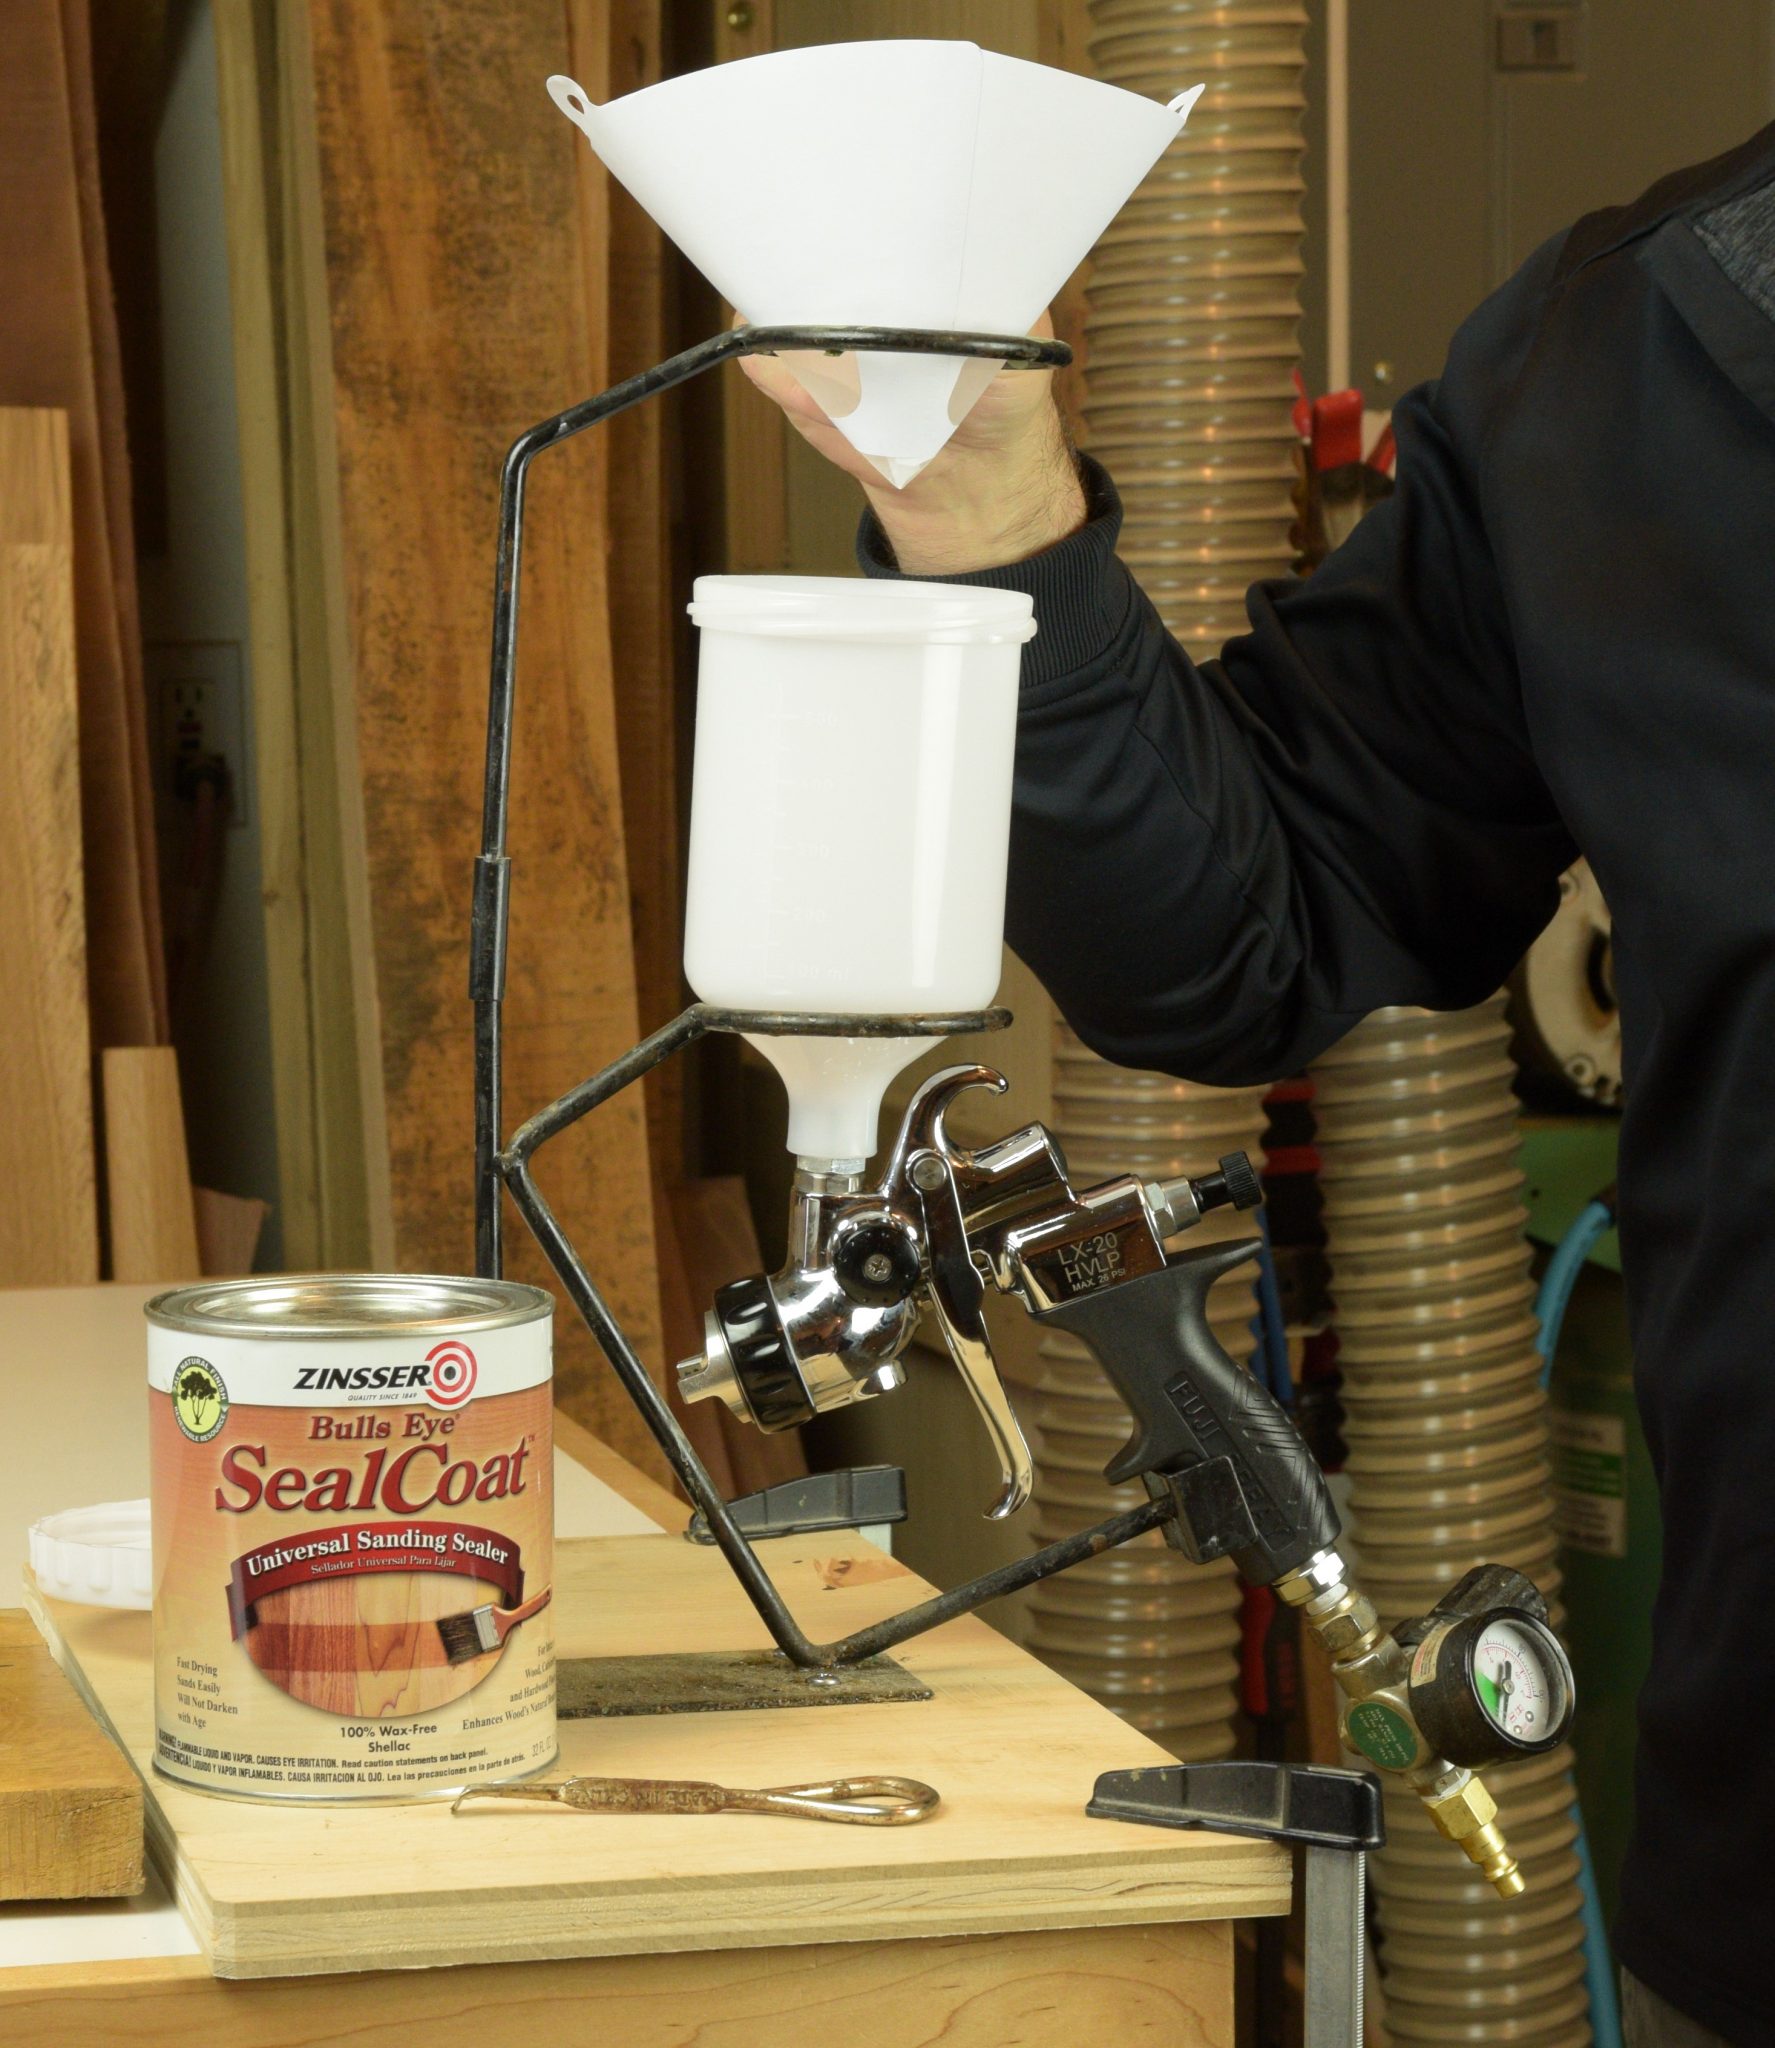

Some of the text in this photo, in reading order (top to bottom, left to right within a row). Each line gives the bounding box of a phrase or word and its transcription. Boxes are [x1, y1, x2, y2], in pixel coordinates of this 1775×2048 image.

[1058, 1232, 1118, 1265] LX-20
[1065, 1251, 1120, 1283] HVLP
[1072, 1278, 1096, 1292] MAX
[180, 1357, 209, 1370] NATURAL
[210, 1369, 227, 1400] FINISH
[1170, 1380, 1220, 1439] FUJI
[308, 1413, 391, 1440] Bulls
[215, 1436, 529, 1514] SealCoat
[246, 1529, 508, 1576] Universal Sanding Sealer
[310, 1555, 456, 1574] Sellador Universal Para Lijar
[176, 1656, 219, 1677] Fast Drying
[176, 1675, 221, 1696] Sands Easily
[510, 1690, 522, 1702] and
[177, 1692, 238, 1714] Will Not Darken
[177, 1711, 207, 1729] with Age
[462, 1715, 503, 1730] Enhances
[505, 1705, 529, 1721] Wood's
[341, 1723, 437, 1739] 100% Wax-Free
[177, 1740, 202, 1756] FLAMMABLE
[203, 1747, 219, 1759] LIQUID
[220, 1750, 231, 1761] AND
[233, 1752, 255, 1764] VAPOR.
[256, 1755, 281, 1767] CAUSES
[283, 1757, 295, 1767] EYE
[297, 1758, 338, 1768] IRRITATION.
[342, 1760, 361, 1768] Read
[364, 1758, 393, 1768] caution
[395, 1755, 437, 1766] statements
[450, 1751, 466, 1761] back
[468, 1747, 488, 1759] panel.
[368, 1740, 411, 1753] Shellac
[193, 1760, 212, 1772] LIQUIDO
[213, 1763, 216, 1772] Y
[218, 1765, 237, 1777] VAPOR
[238, 1768, 285, 1781] INFLAMABLES.
[287, 1772, 311, 1782] CAUSA
[313, 1772, 355, 1783] IRRITACION
[357, 1773, 365, 1782] AL
[368, 1772, 384, 1782] OJO.
[387, 1772, 401, 1781] Lea
[404, 1771, 416, 1780] las
[418, 1768, 467, 1780] precauciones
[469, 1764, 477, 1772] en
[479, 1762, 485, 1771] la
[486, 1760, 503, 1771] parte
[503, 1757, 510, 1765] de
